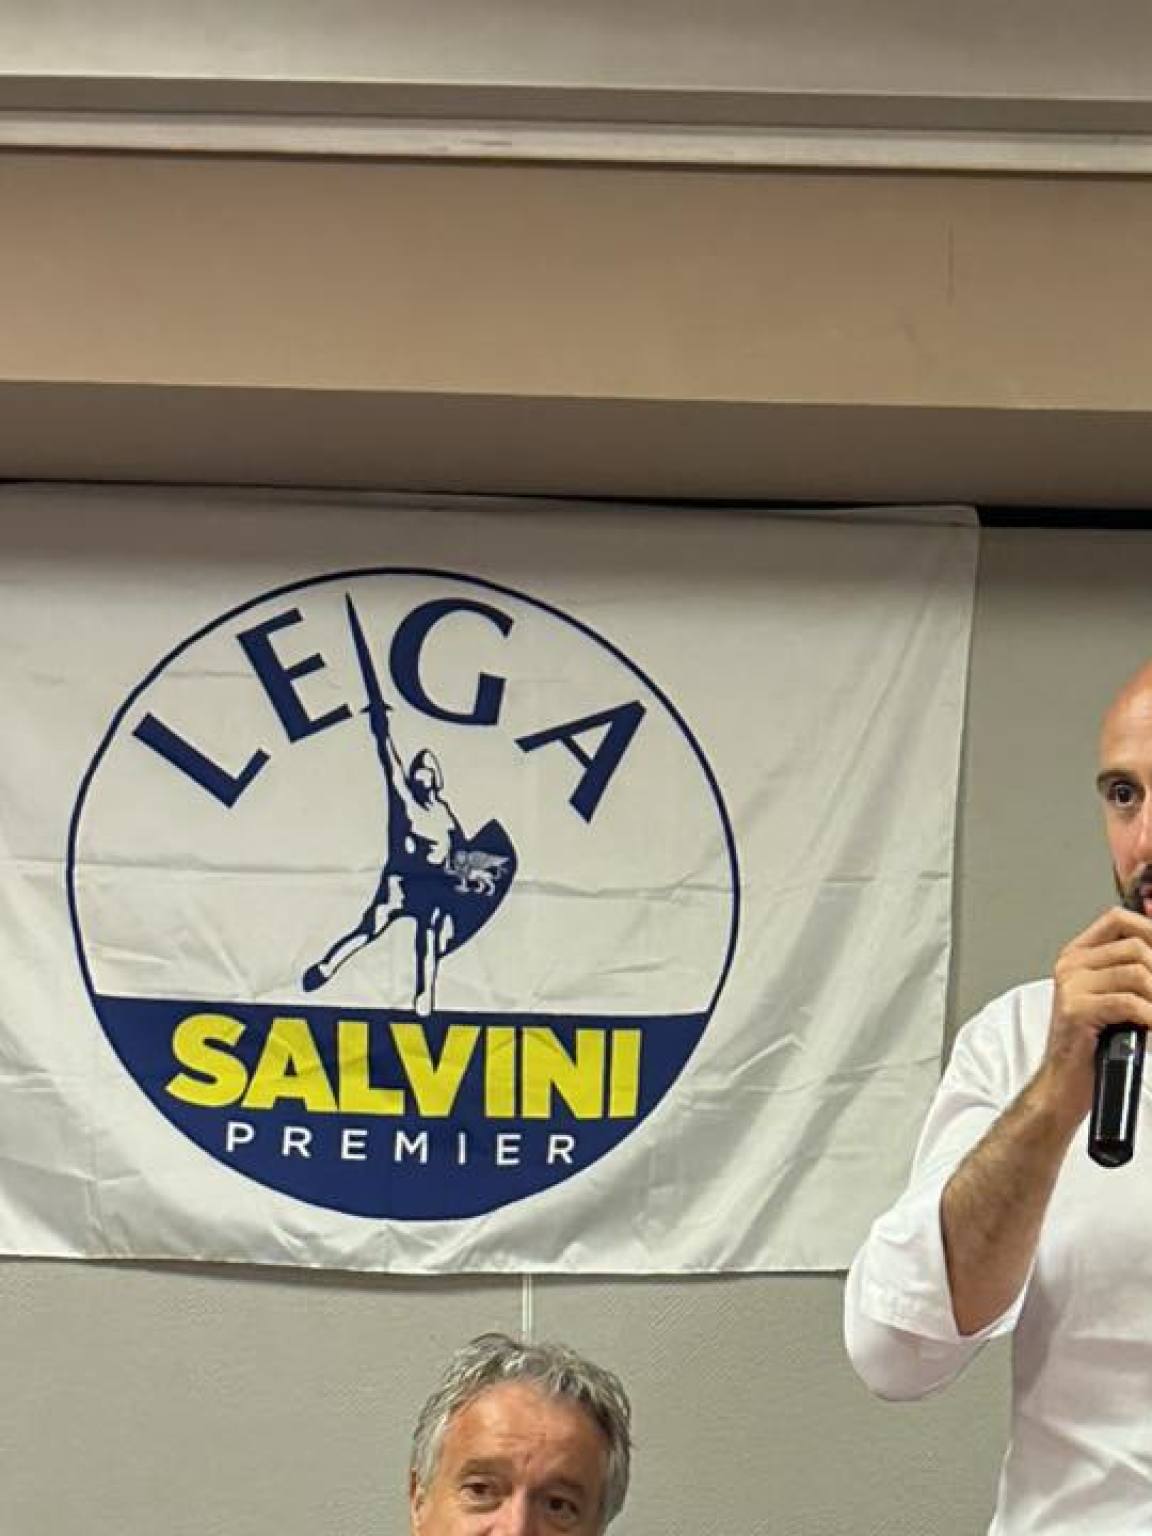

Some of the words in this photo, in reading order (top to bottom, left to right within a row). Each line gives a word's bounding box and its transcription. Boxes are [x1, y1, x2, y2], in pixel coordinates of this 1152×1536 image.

[132, 597, 647, 823] LEGA
[165, 1013, 641, 1119] SALVINI
[226, 1122, 574, 1166] PREMIER
